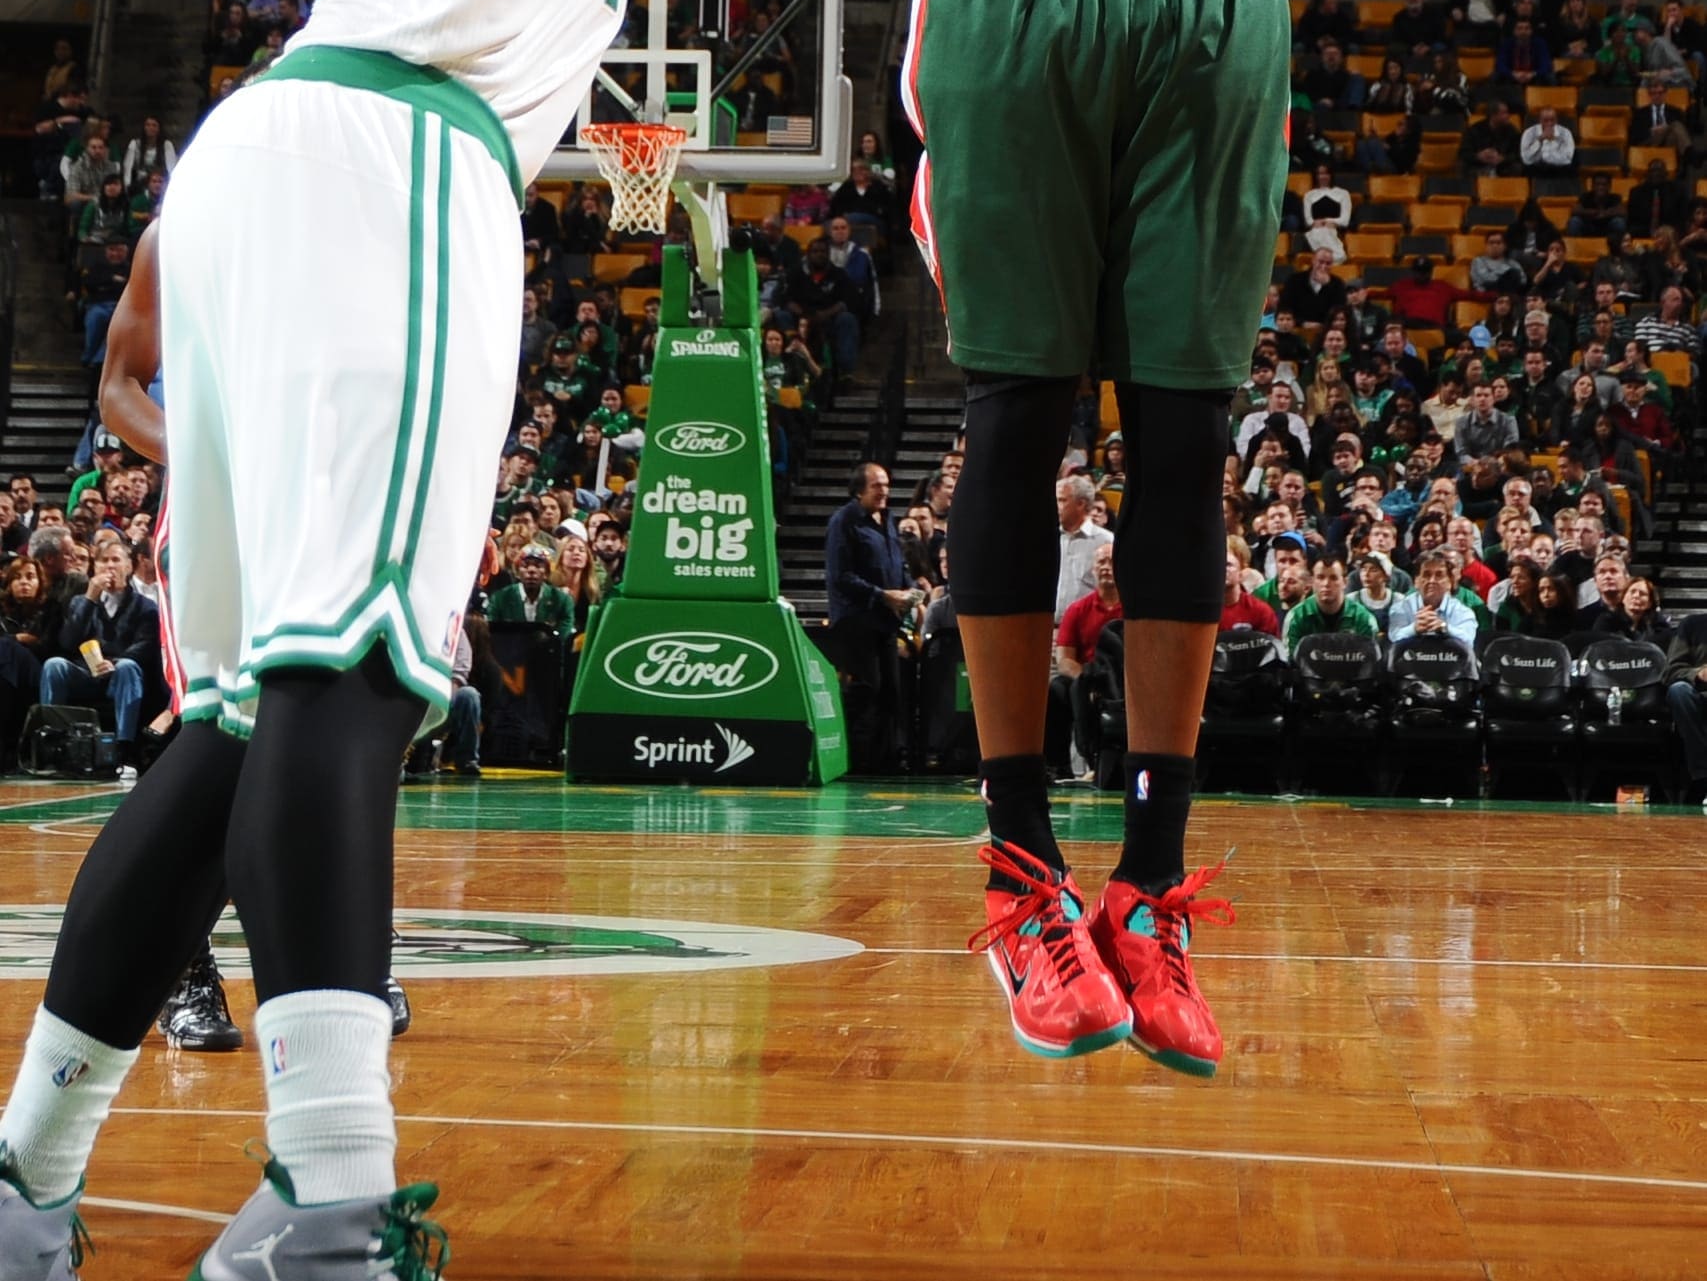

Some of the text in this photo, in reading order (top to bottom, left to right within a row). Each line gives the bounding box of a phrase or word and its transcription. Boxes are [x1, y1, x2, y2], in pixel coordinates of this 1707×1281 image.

[671, 340, 740, 358] SPALDING
[670, 425, 730, 452] Ford
[666, 475, 692, 489] the
[643, 482, 747, 515] dream
[664, 516, 754, 561] big
[674, 563, 756, 578] sales event
[1227, 638, 1271, 651] Sun Life
[634, 640, 748, 687] Ford
[1323, 652, 1366, 662] Sun Life
[1415, 652, 1459, 662] Sun Life
[1513, 657, 1557, 668] Sun Life
[1608, 658, 1652, 670] Sun Life
[634, 736, 716, 768] Sprint
